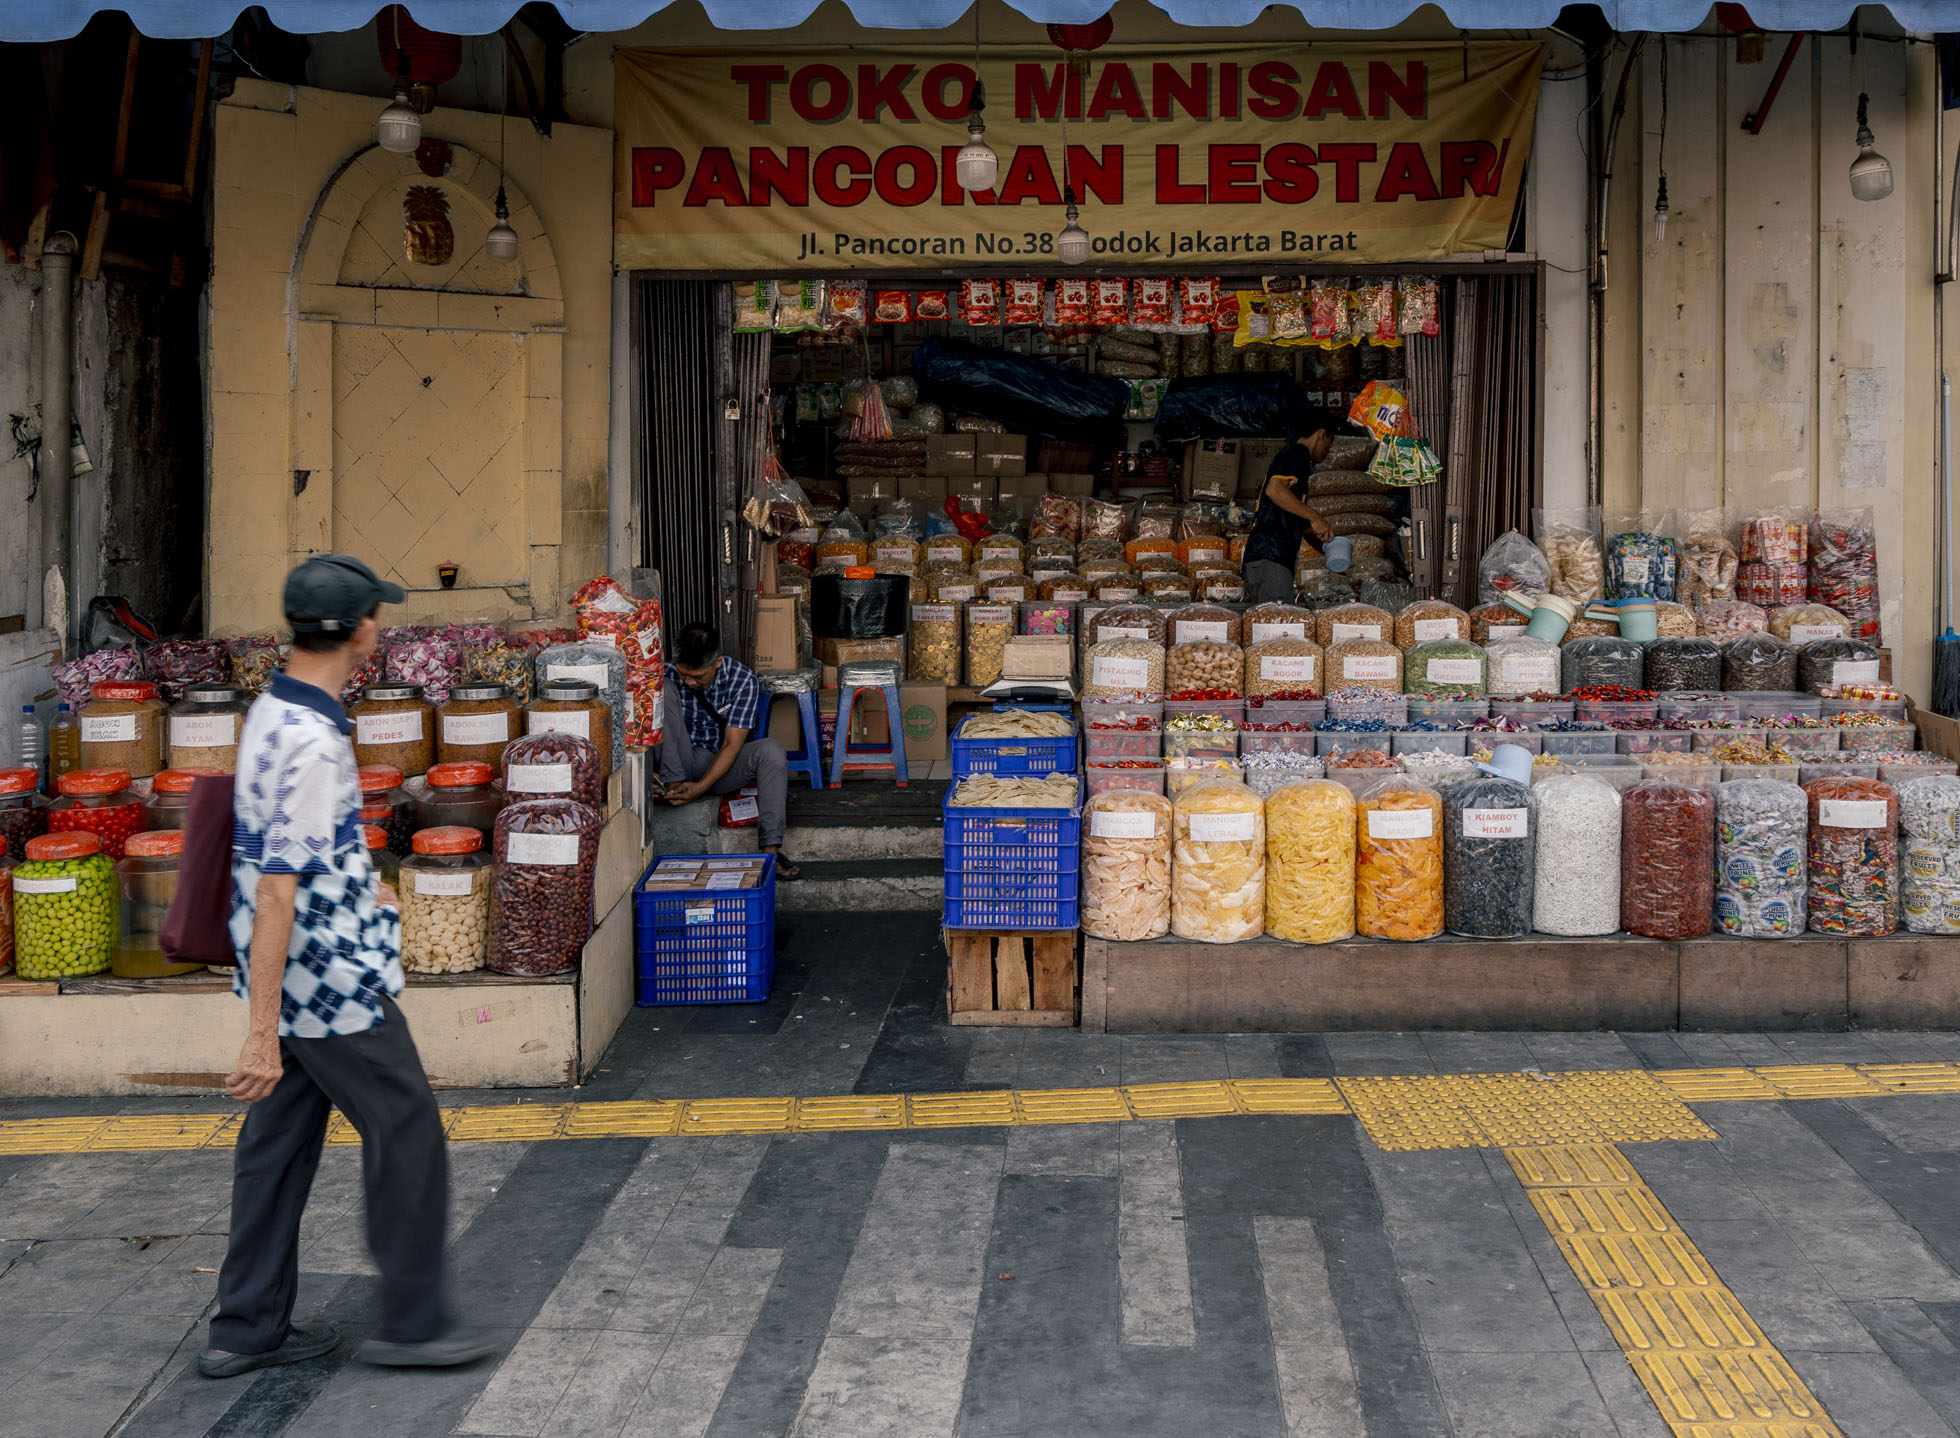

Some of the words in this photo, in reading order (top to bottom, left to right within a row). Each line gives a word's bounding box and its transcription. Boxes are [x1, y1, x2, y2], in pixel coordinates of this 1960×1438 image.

[731, 64, 982, 123] TOKO
[1015, 61, 1426, 121] MANISAN
[798, 233, 824, 260] Jl.
[834, 233, 966, 254] Pancoran
[975, 232, 1055, 254] No.38
[1166, 231, 1271, 258] Jakarta
[1280, 231, 1358, 254] Barat
[1184, 625, 1217, 633] ALMOND
[1271, 659, 1305, 667] KACANG
[184, 720, 213, 729] ABON
[363, 717, 390, 727] ABON
[371, 731, 404, 741] PEDES
[1474, 813, 1518, 822] KIAMBOY
[1482, 826, 1512, 834] HITAM
